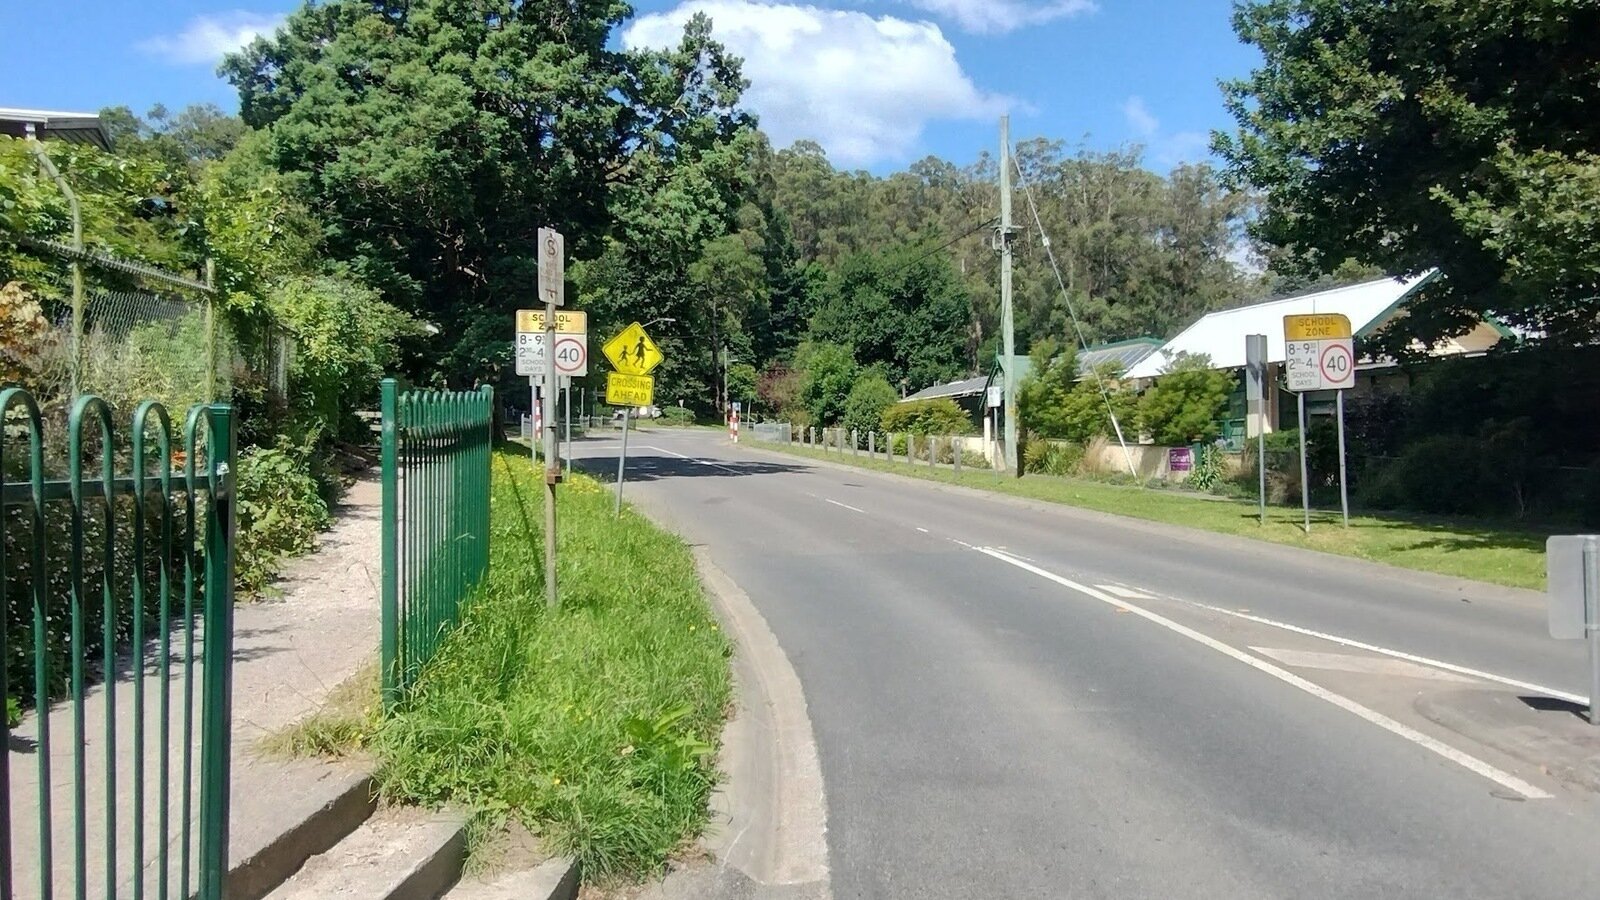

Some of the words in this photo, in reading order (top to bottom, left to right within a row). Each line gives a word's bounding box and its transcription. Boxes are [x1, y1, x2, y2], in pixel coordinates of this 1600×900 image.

[532, 313, 571, 323] SCOL
[1299, 317, 1336, 327] SCHOOL
[1305, 327, 1331, 337] ZONE
[558, 347, 579, 363] 40
[1326, 355, 1347, 372] 40
[611, 377, 651, 390] CROSSING
[613, 390, 647, 402] AHEAD
